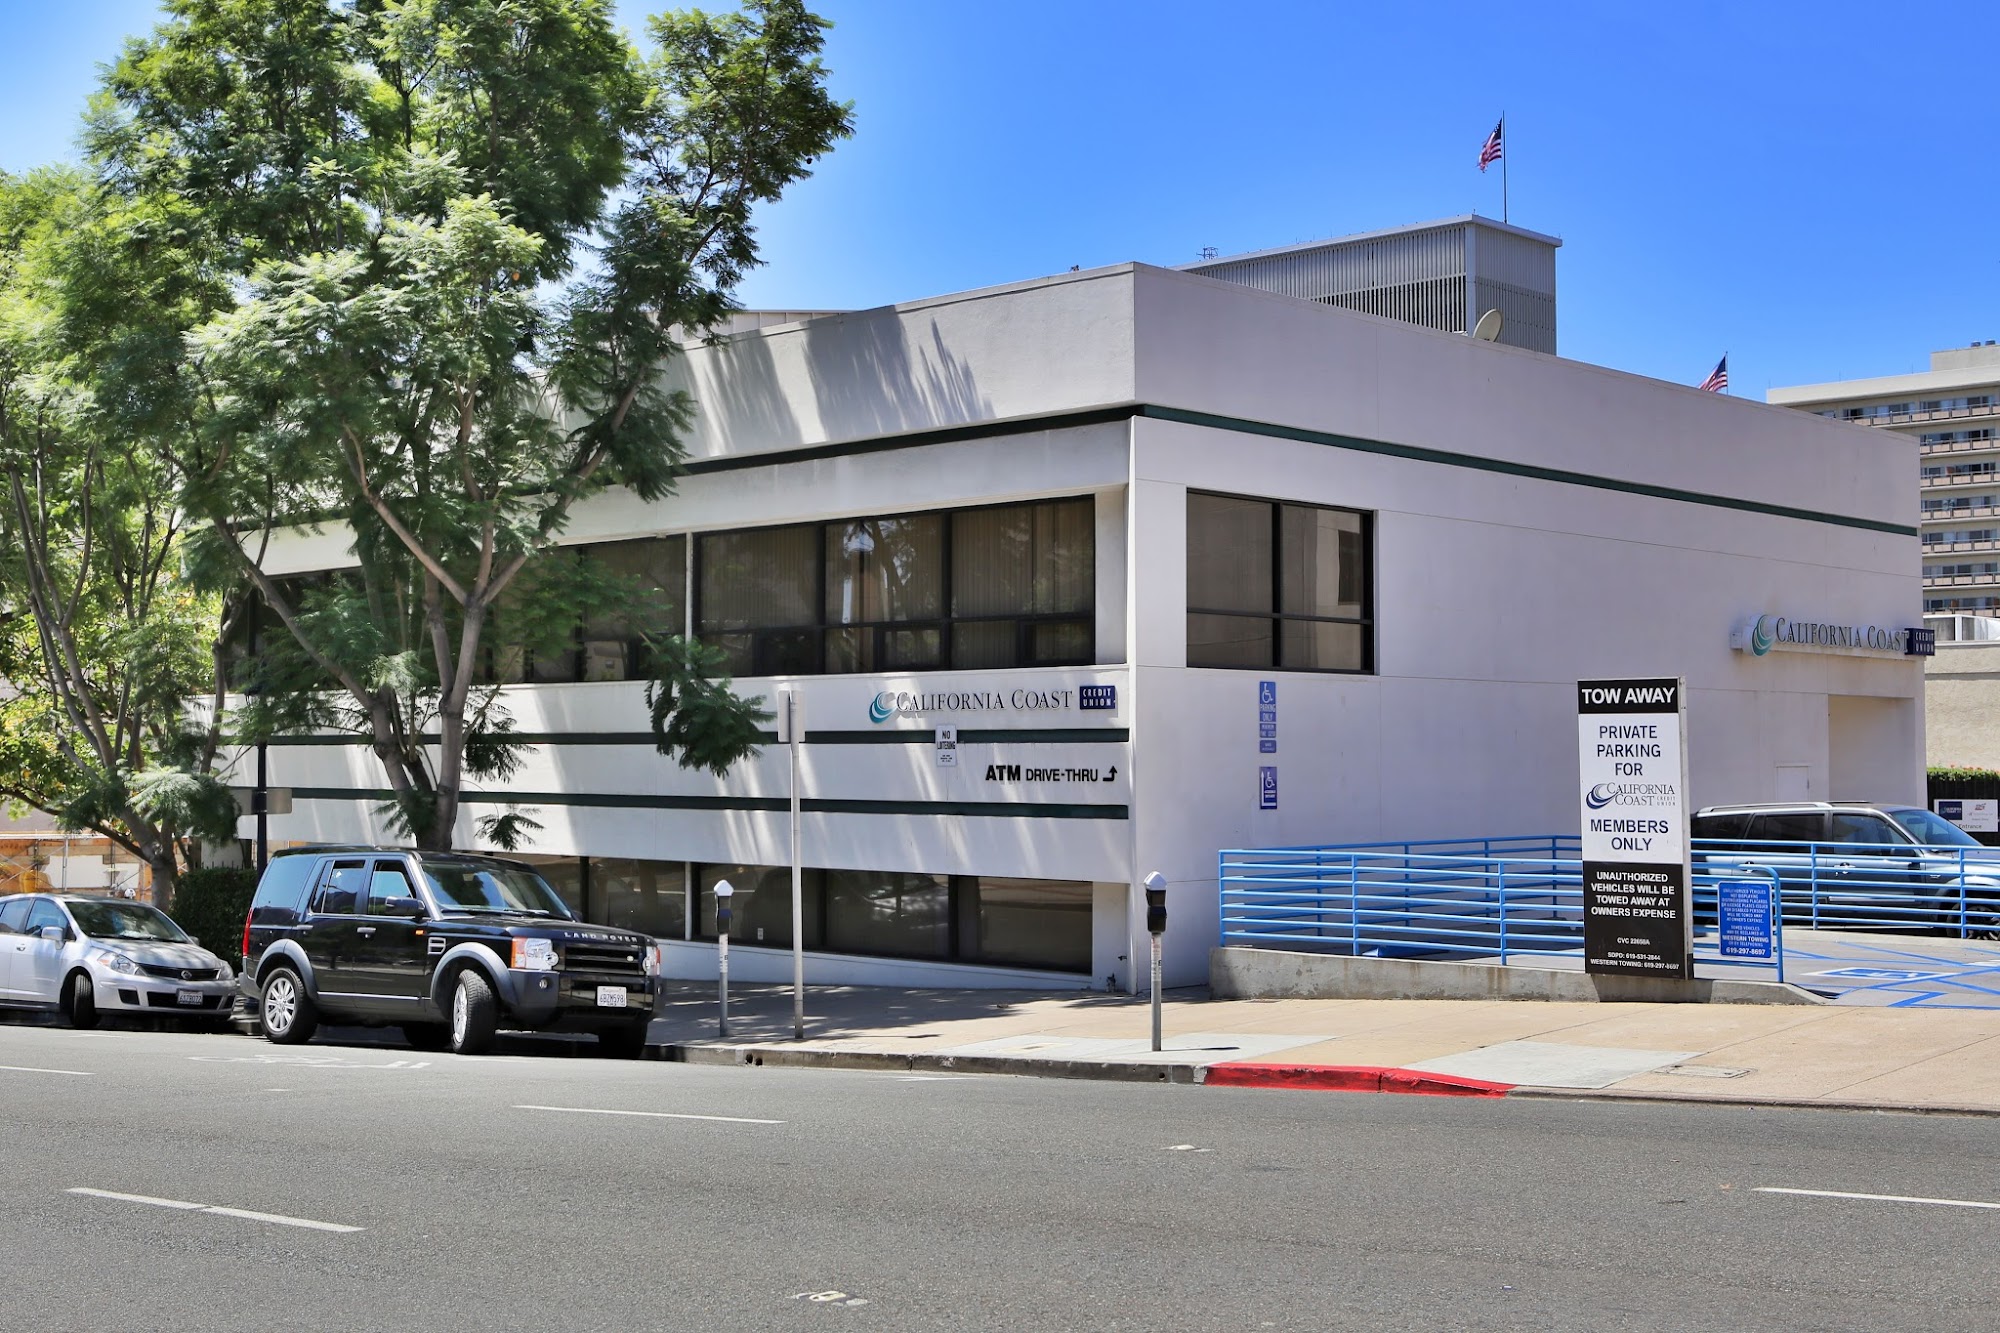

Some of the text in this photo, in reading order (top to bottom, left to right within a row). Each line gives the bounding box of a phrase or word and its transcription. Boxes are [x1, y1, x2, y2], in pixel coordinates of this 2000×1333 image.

[1776, 617, 1909, 653] CALIFORNIA COAST
[1915, 632, 1934, 641] CREDIT
[1915, 643, 1934, 652] UNION
[1083, 688, 1111, 697] CREDIT
[1581, 687, 1675, 704] TOW AWAY
[896, 689, 1073, 711] CALIFORNIA COAST
[1083, 698, 1111, 706] UNION
[942, 730, 951, 739] NO
[1599, 725, 1658, 739] PRIVATE
[1597, 744, 1661, 758] PARKING
[985, 764, 1098, 782] ATM DRIVE-THRU
[1615, 762, 1643, 776] FOR
[1606, 782, 1675, 795] CALIFORNIA
[1614, 794, 1654, 806] COAST
[1590, 819, 1669, 834] MEMBERS
[1611, 837, 1652, 851] ONLY
[1596, 871, 1668, 882] UNAUTHORIZED
[1591, 883, 1675, 895] VEHICLES WILL BE
[1596, 895, 1670, 907] TOWED AWAY AT
[1591, 906, 1676, 919] OWNERS EXPENSE
[602, 934, 638, 942] ROVER
[1619, 960, 1643, 968] TOWING:
[1644, 962, 1679, 970] 619-297-8697
